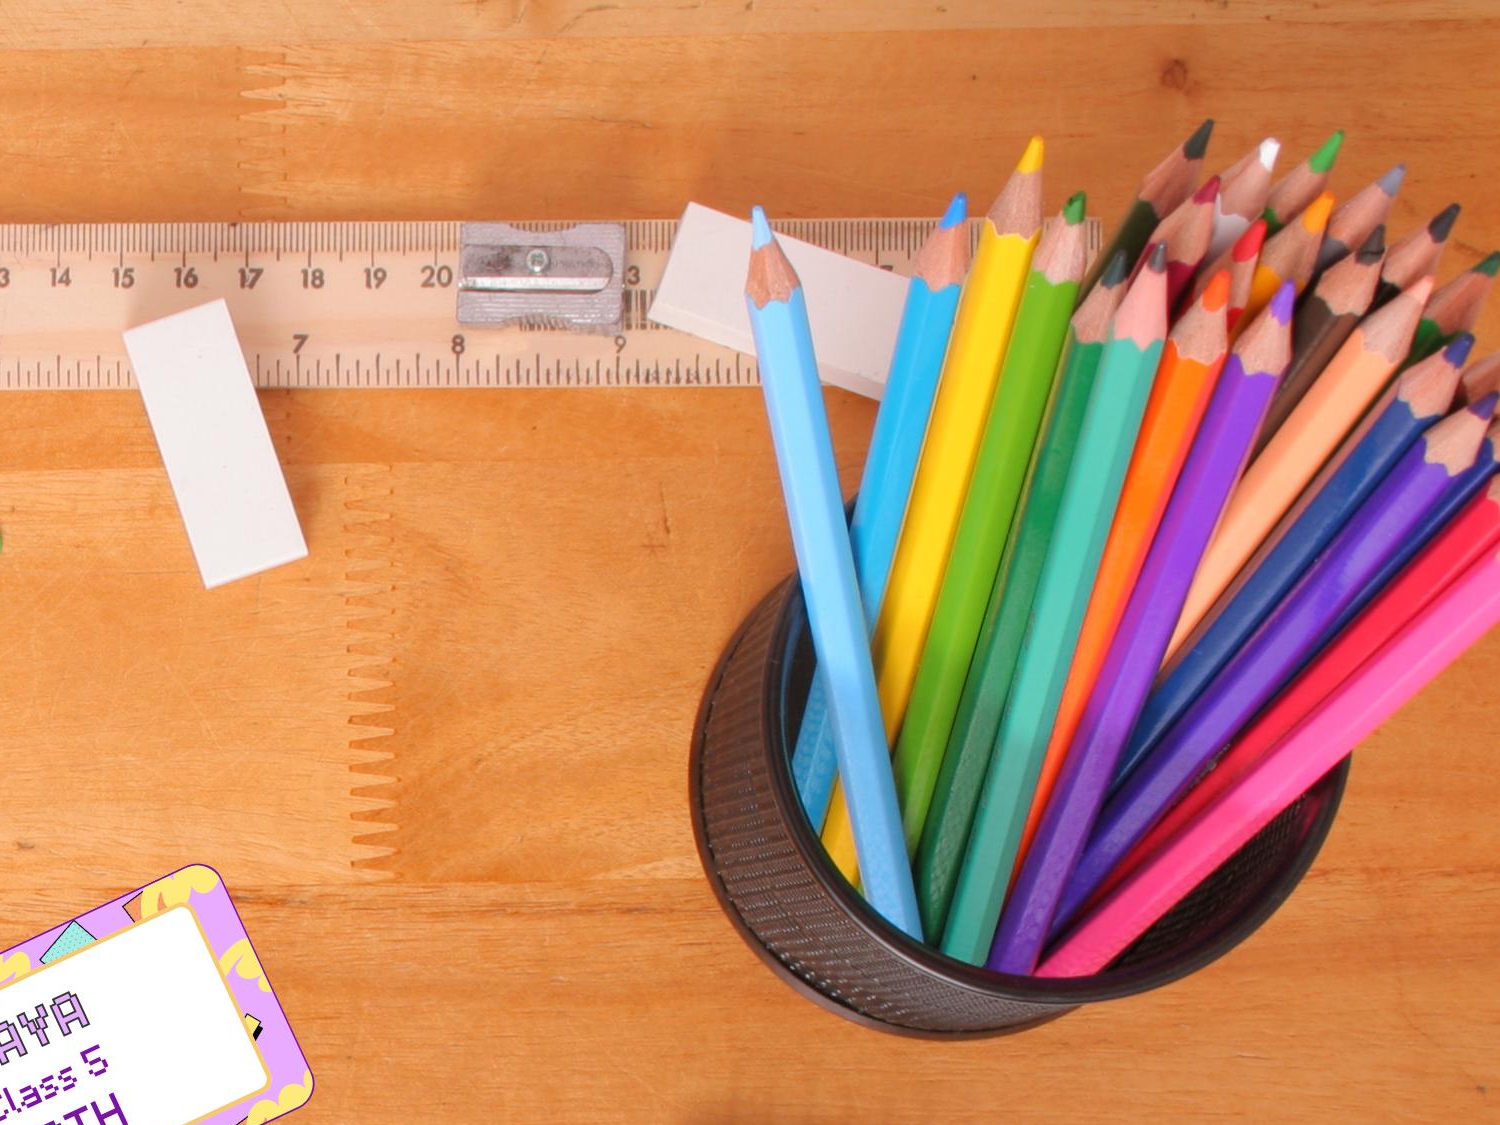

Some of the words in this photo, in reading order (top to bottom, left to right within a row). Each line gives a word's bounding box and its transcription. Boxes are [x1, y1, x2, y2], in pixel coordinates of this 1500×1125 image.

[49, 266, 72, 288] 14
[112, 267, 135, 289] 15
[173, 266, 199, 289] 16
[237, 267, 264, 289] 17
[300, 267, 326, 290] 18
[363, 267, 388, 290] 19
[420, 265, 453, 289] 20
[626, 265, 641, 286] 3
[292, 334, 310, 354] 7
[450, 334, 466, 355] 8
[613, 335, 627, 354] 9
[79, 1044, 109, 1077] 5
